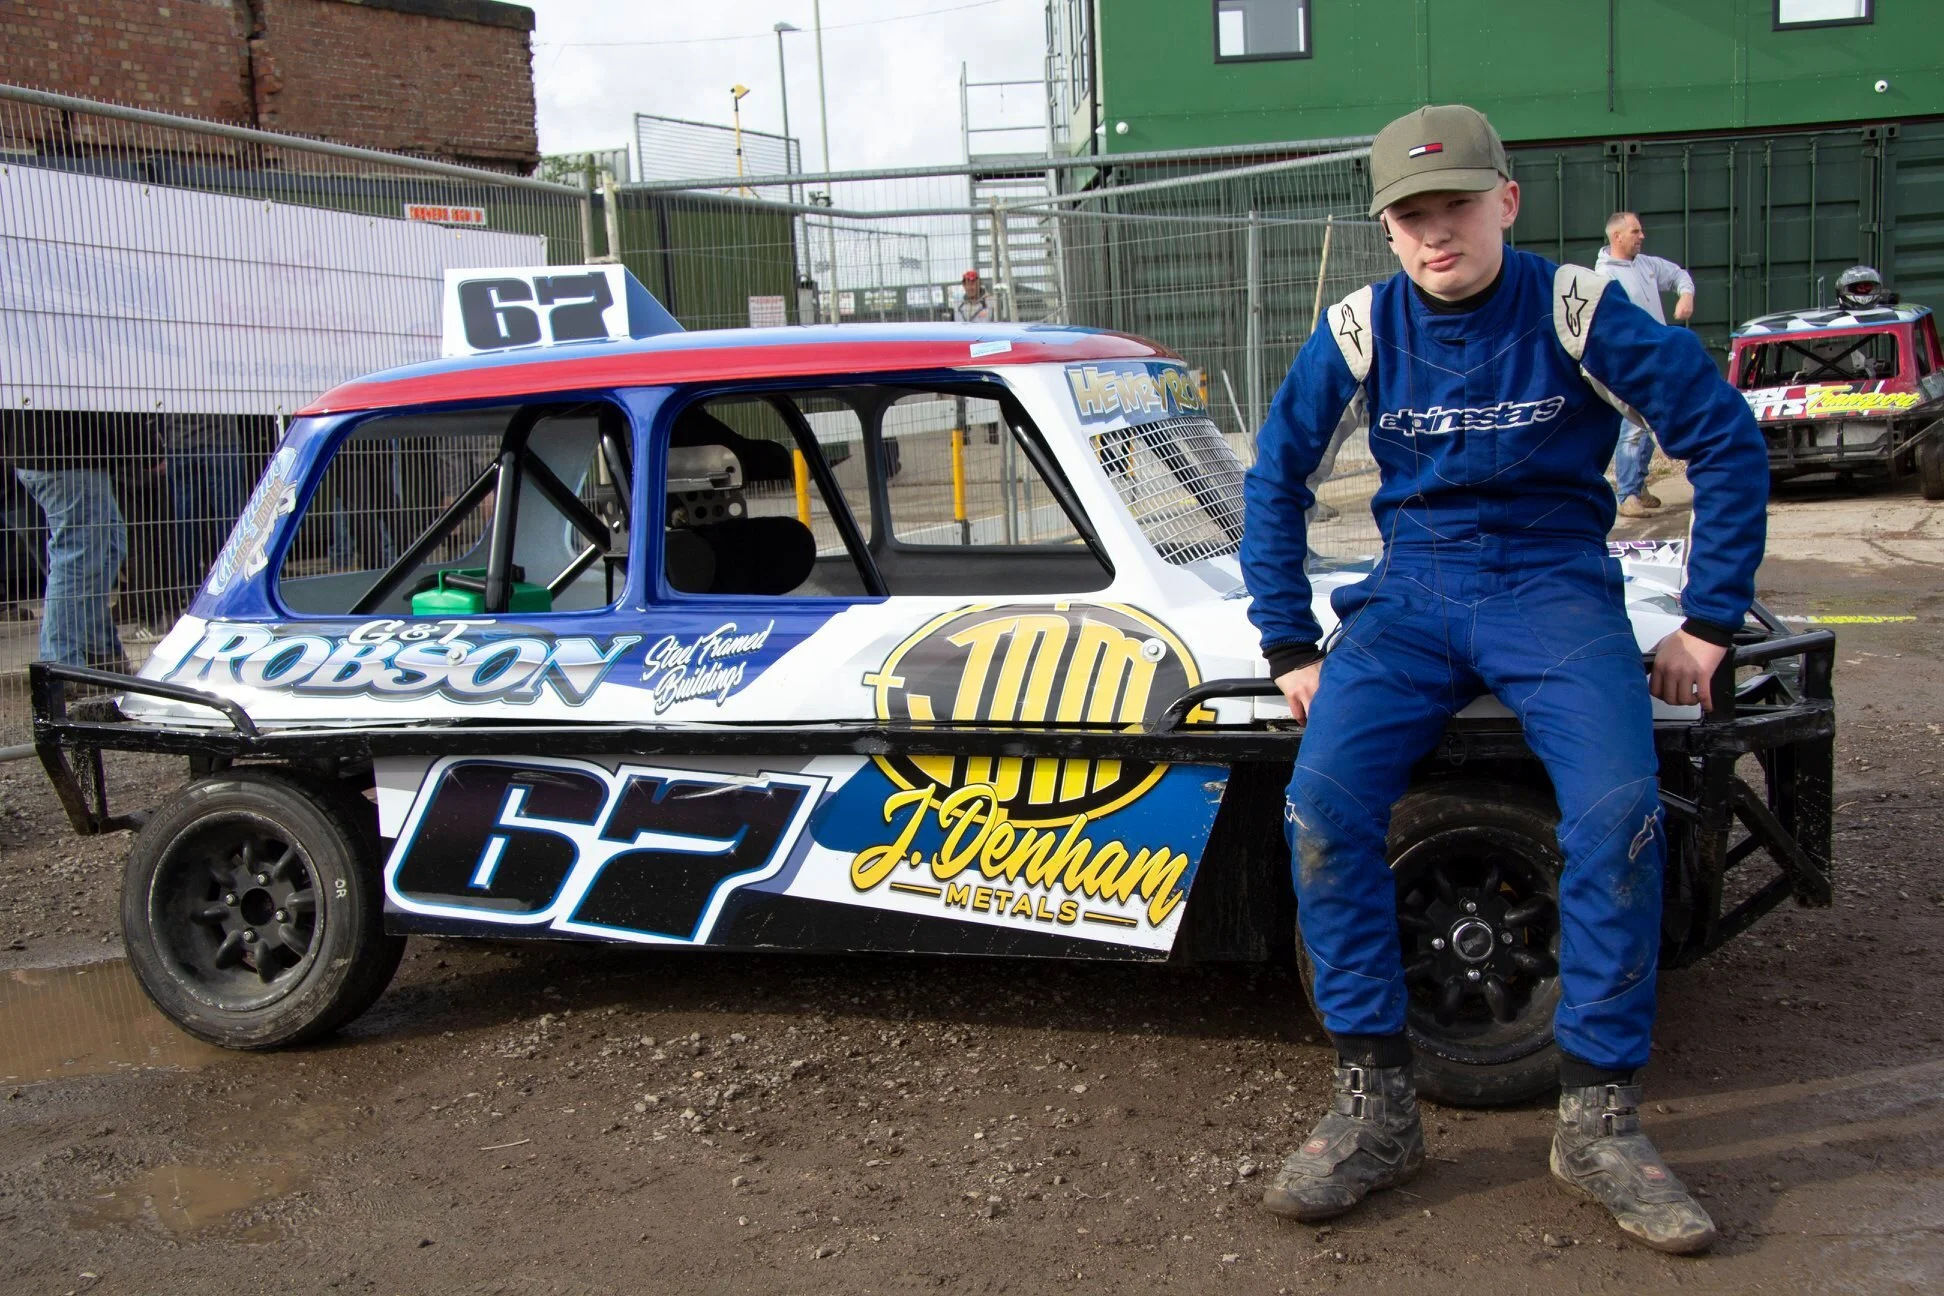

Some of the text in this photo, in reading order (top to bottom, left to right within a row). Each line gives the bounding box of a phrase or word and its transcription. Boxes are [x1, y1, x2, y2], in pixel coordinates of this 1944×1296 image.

[457, 271, 614, 351] 67
[1379, 395, 1565, 437] alpinestars
[1807, 385, 1921, 413] Transport
[348, 618, 497, 646] G&T
[641, 619, 775, 682] Steel Framed
[163, 621, 642, 704] ROBSON
[654, 662, 747, 714] Buildings
[388, 757, 820, 943] 67
[932, 783, 1188, 927] Denham
[946, 884, 1078, 922] METALS
